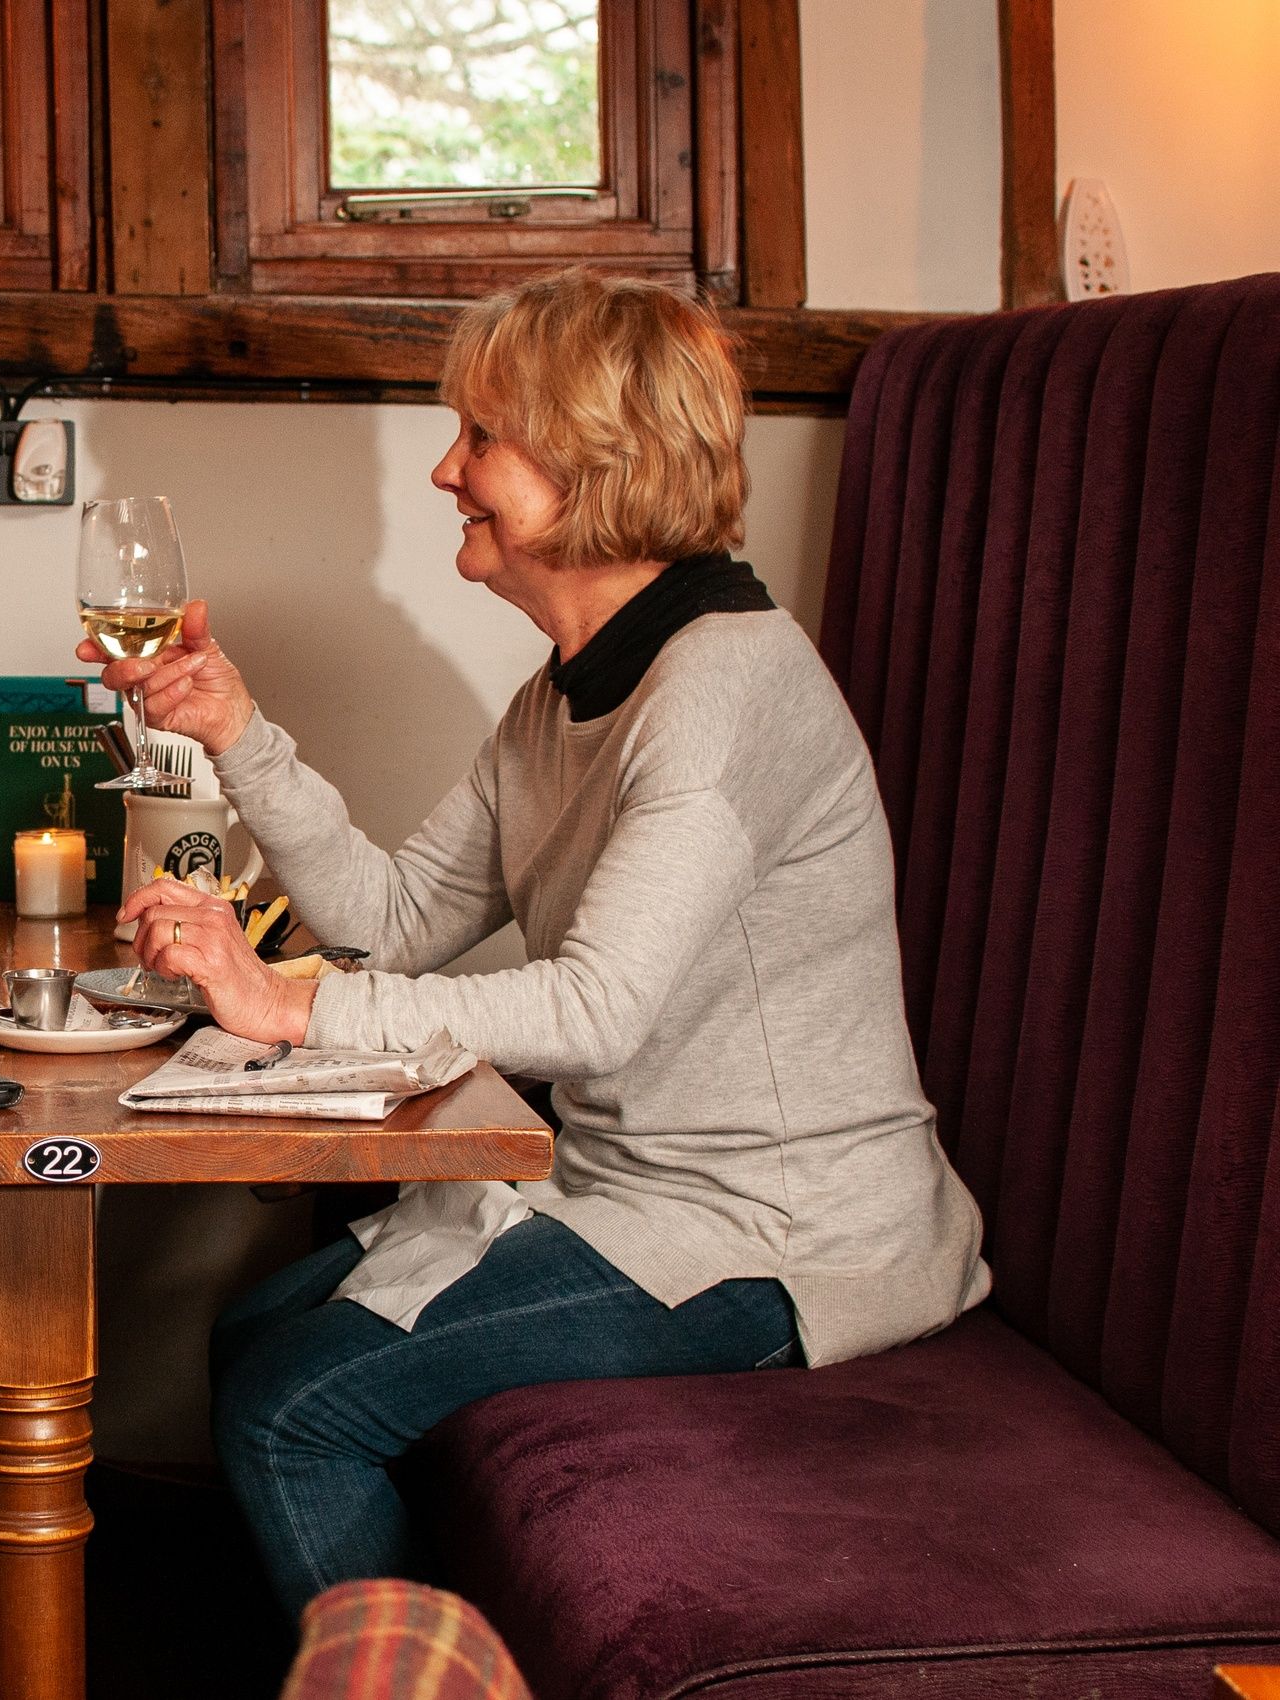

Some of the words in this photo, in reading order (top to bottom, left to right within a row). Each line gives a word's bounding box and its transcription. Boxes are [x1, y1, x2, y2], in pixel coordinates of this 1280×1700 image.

[9, 725, 49, 739] ENJOY
[51, 726, 60, 738] A
[63, 725, 97, 738] BOT
[9, 740, 27, 753] OF
[31, 740, 75, 753] HOUSE
[78, 740, 105, 753] WIN
[41, 755, 60, 768] ON
[63, 755, 81, 768] US
[171, 834, 221, 858] BADGER
[42, 1145, 83, 1175] 22
